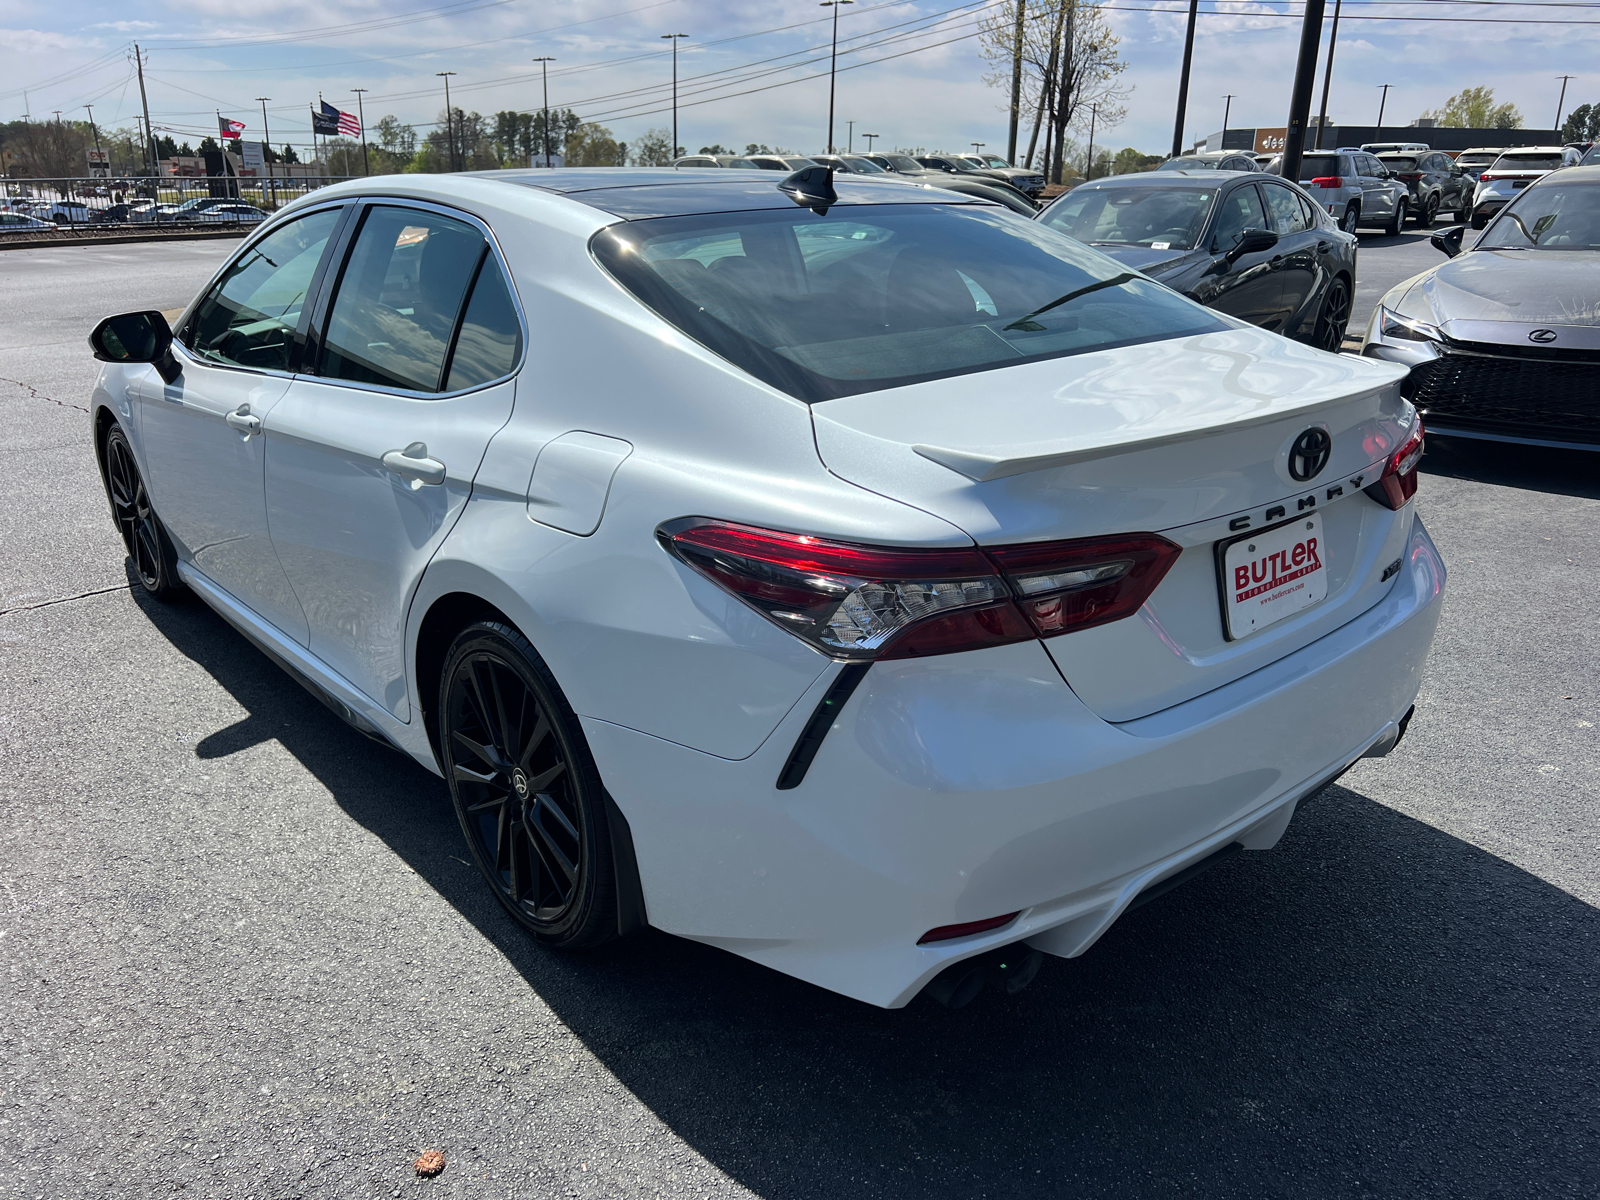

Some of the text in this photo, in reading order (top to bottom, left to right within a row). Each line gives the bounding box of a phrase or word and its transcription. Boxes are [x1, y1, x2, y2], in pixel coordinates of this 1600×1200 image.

[1262, 135, 1287, 149] Jee
[1229, 474, 1365, 531] CAMRY
[1260, 583, 1305, 605] www.butlercars.com
